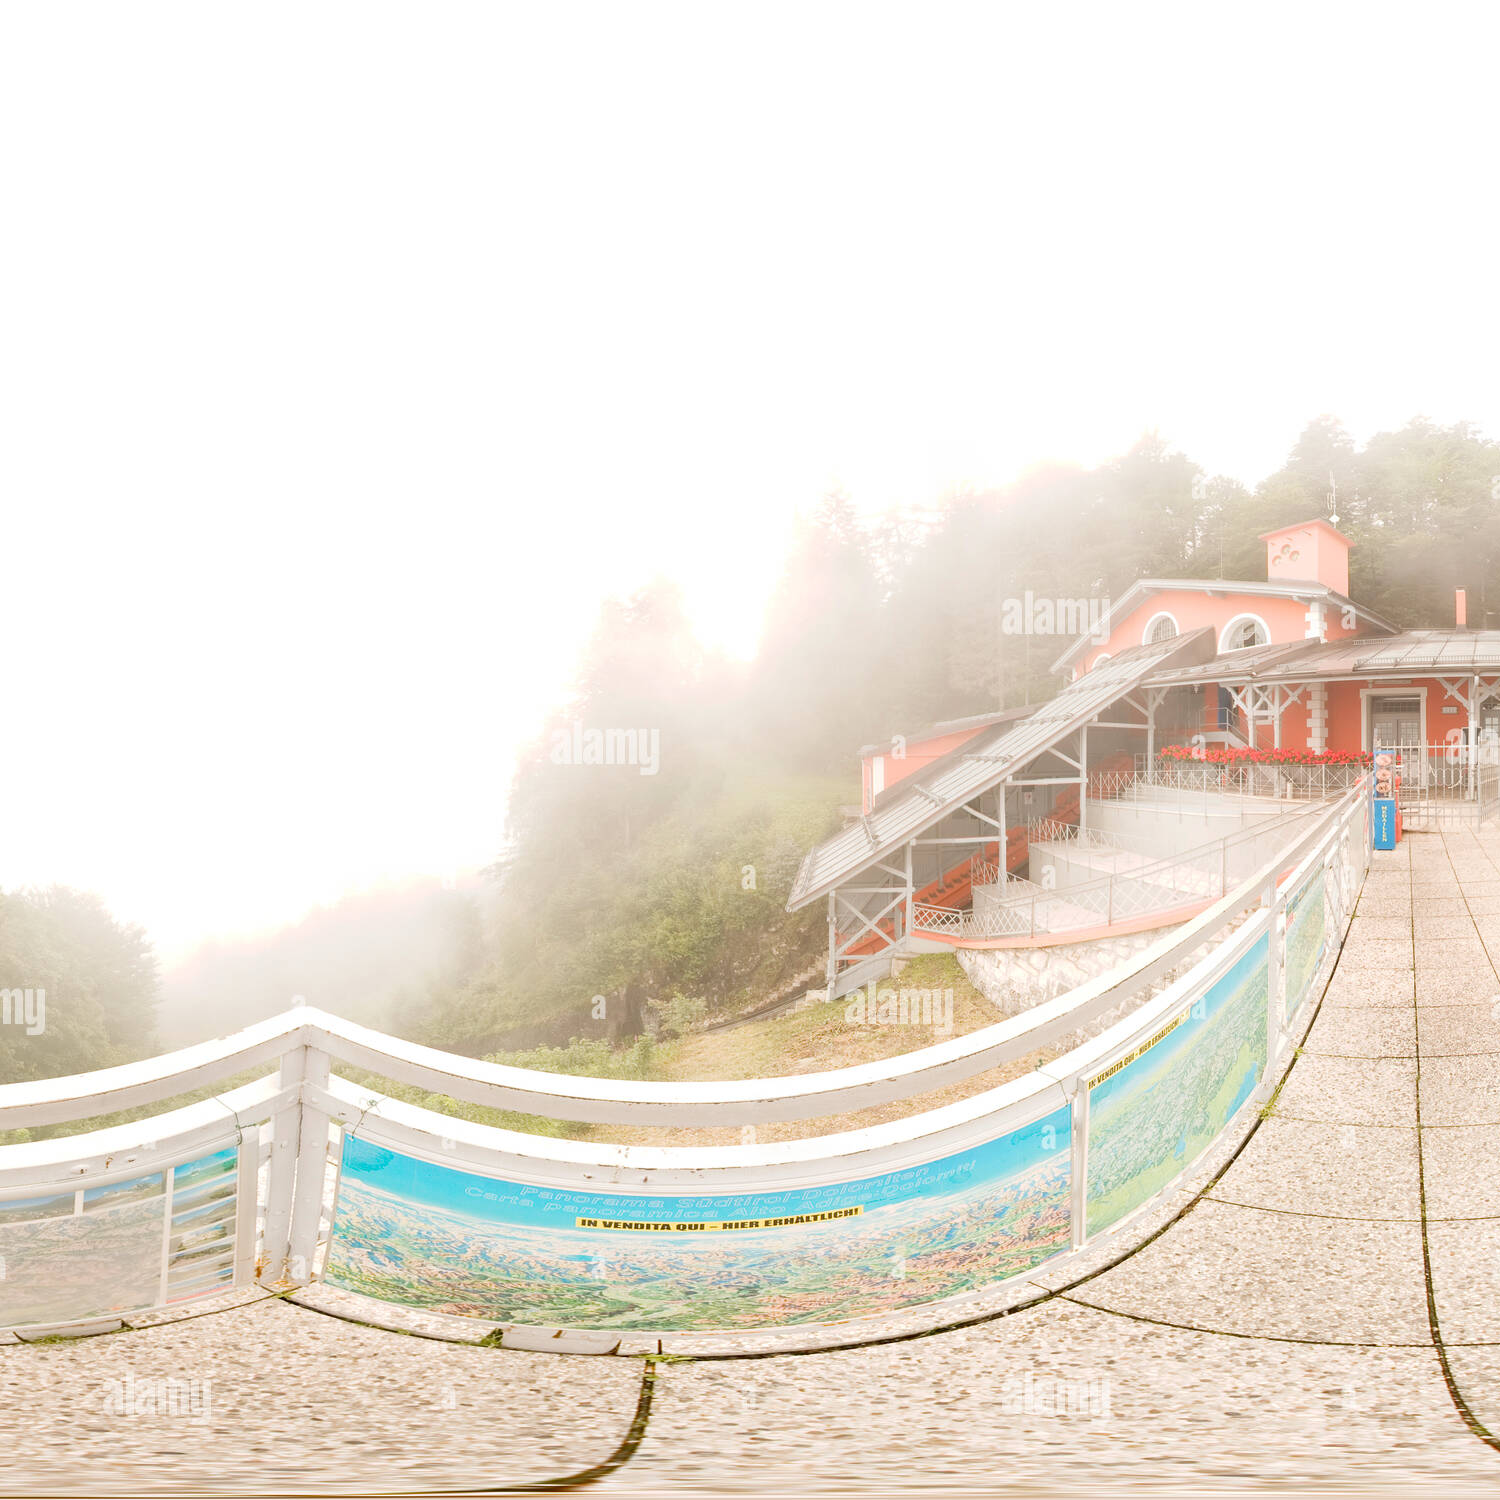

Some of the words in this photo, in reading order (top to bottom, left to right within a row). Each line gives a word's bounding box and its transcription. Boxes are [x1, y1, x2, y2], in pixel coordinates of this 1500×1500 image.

[1097, 1060, 1124, 1084] VENDITA
[581, 1218, 598, 1228] IN
[602, 1220, 672, 1231] VENDITA
[675, 1223, 705, 1232] QUI
[721, 1221, 760, 1230] HIER
